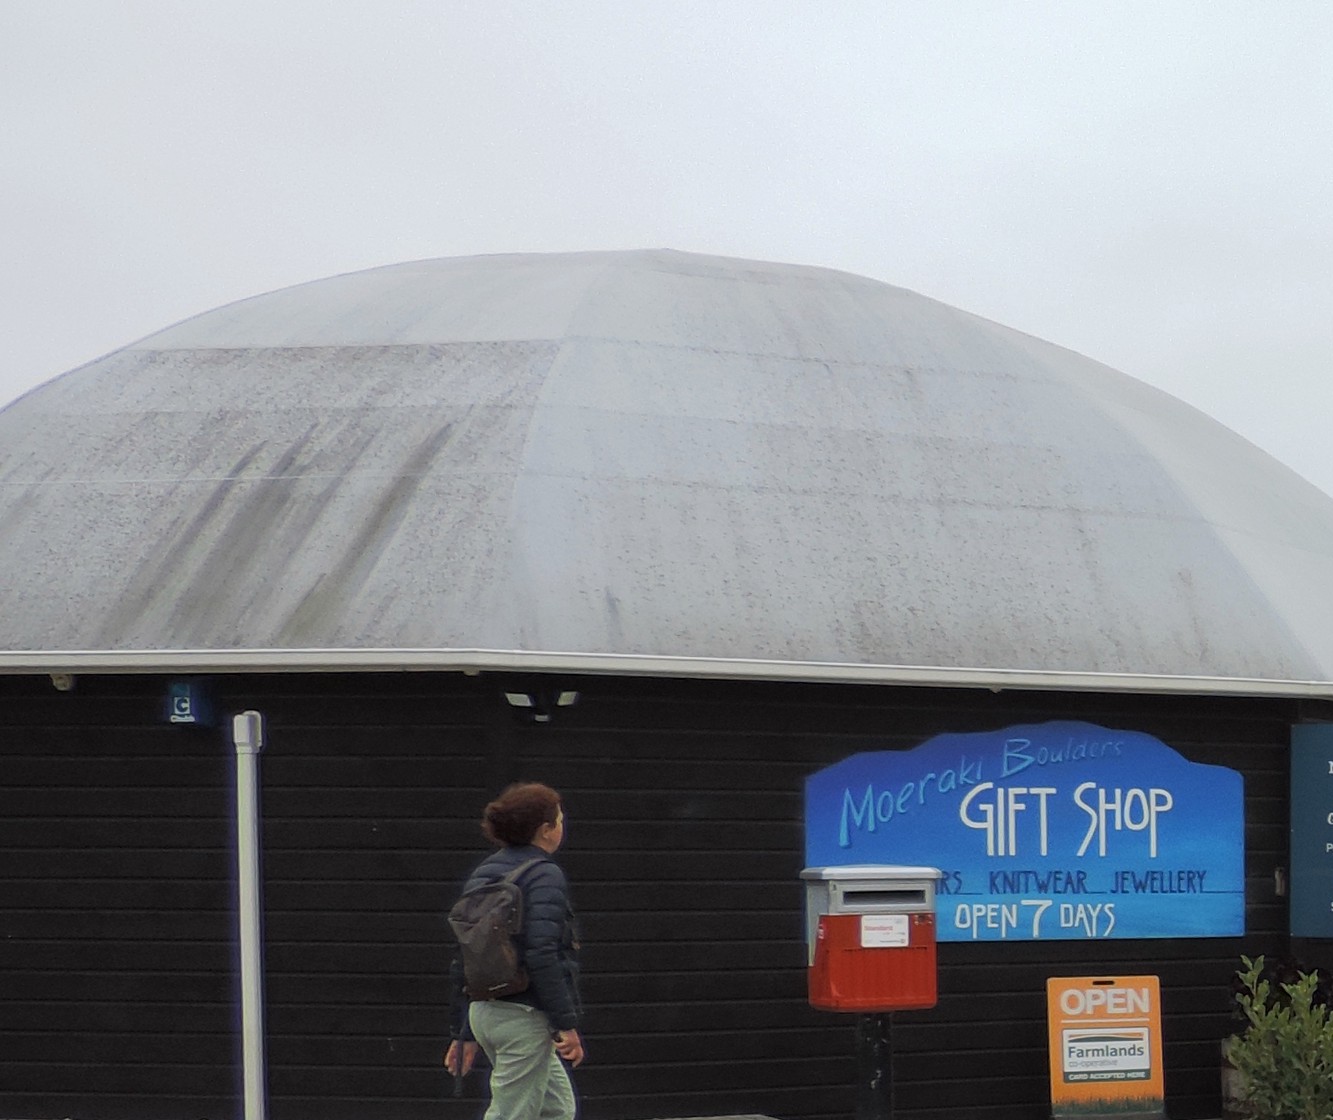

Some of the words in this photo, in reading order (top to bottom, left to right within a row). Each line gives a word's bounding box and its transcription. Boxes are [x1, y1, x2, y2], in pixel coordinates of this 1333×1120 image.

[837, 755, 983, 849] Moeraki
[999, 736, 1125, 779] Boulders
[959, 782, 1057, 857] GIFT
[1074, 782, 1173, 858] SHOP
[989, 870, 1088, 895] KNITWEAR
[1110, 870, 1207, 895] JEWELLERY
[954, 903, 1018, 939] OPEN
[1021, 899, 1053, 939] 7
[1060, 903, 1115, 938] DAYS
[1060, 987, 1150, 1015] OPEN
[1068, 1044, 1144, 1058] Farmlands
